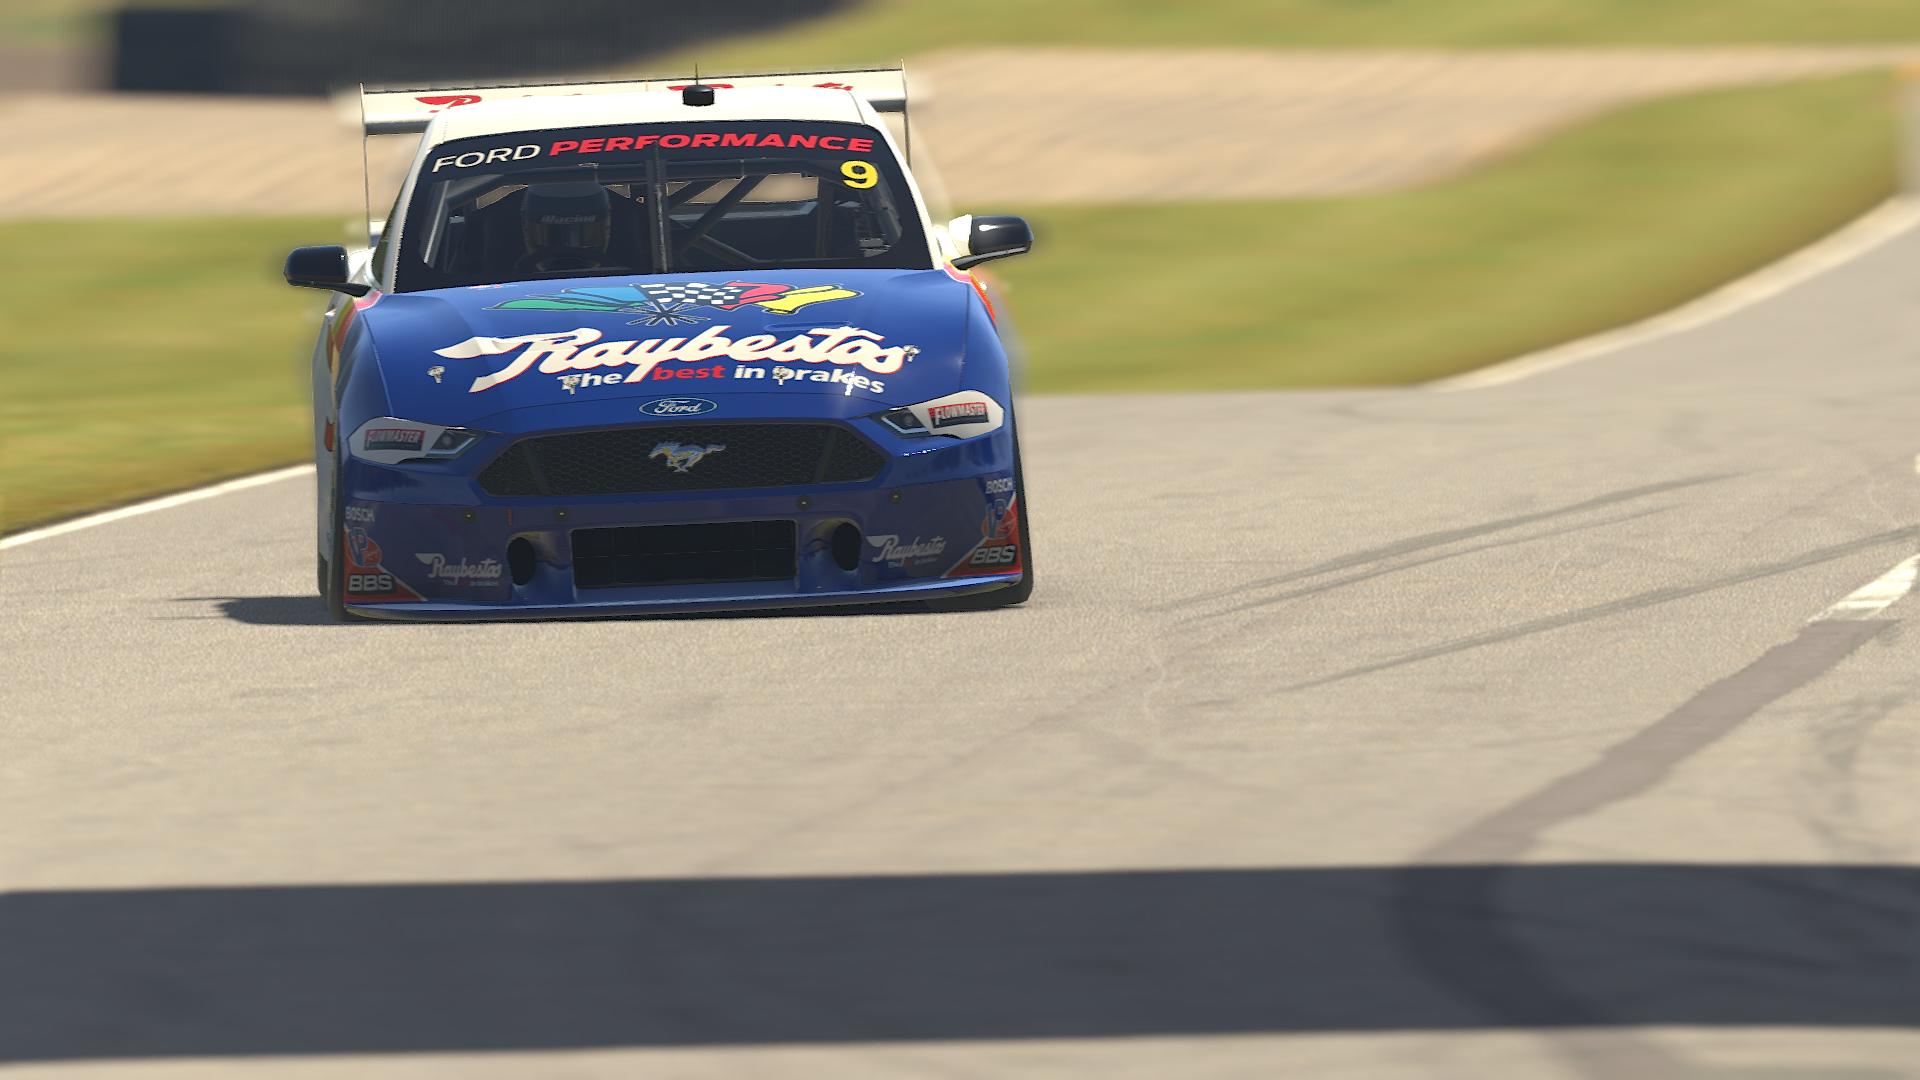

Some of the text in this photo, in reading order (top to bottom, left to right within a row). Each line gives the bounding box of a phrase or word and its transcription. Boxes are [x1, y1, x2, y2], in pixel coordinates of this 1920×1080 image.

[432, 133, 875, 173] FORD PERFORMANCE
[840, 160, 879, 189] 9
[433, 326, 907, 393] Raybestos
[652, 364, 726, 381] best
[734, 365, 766, 379] in
[653, 399, 702, 414] Ford
[345, 506, 376, 522] BOSCH
[971, 546, 1015, 564] BBS
[348, 575, 392, 592] BBS
